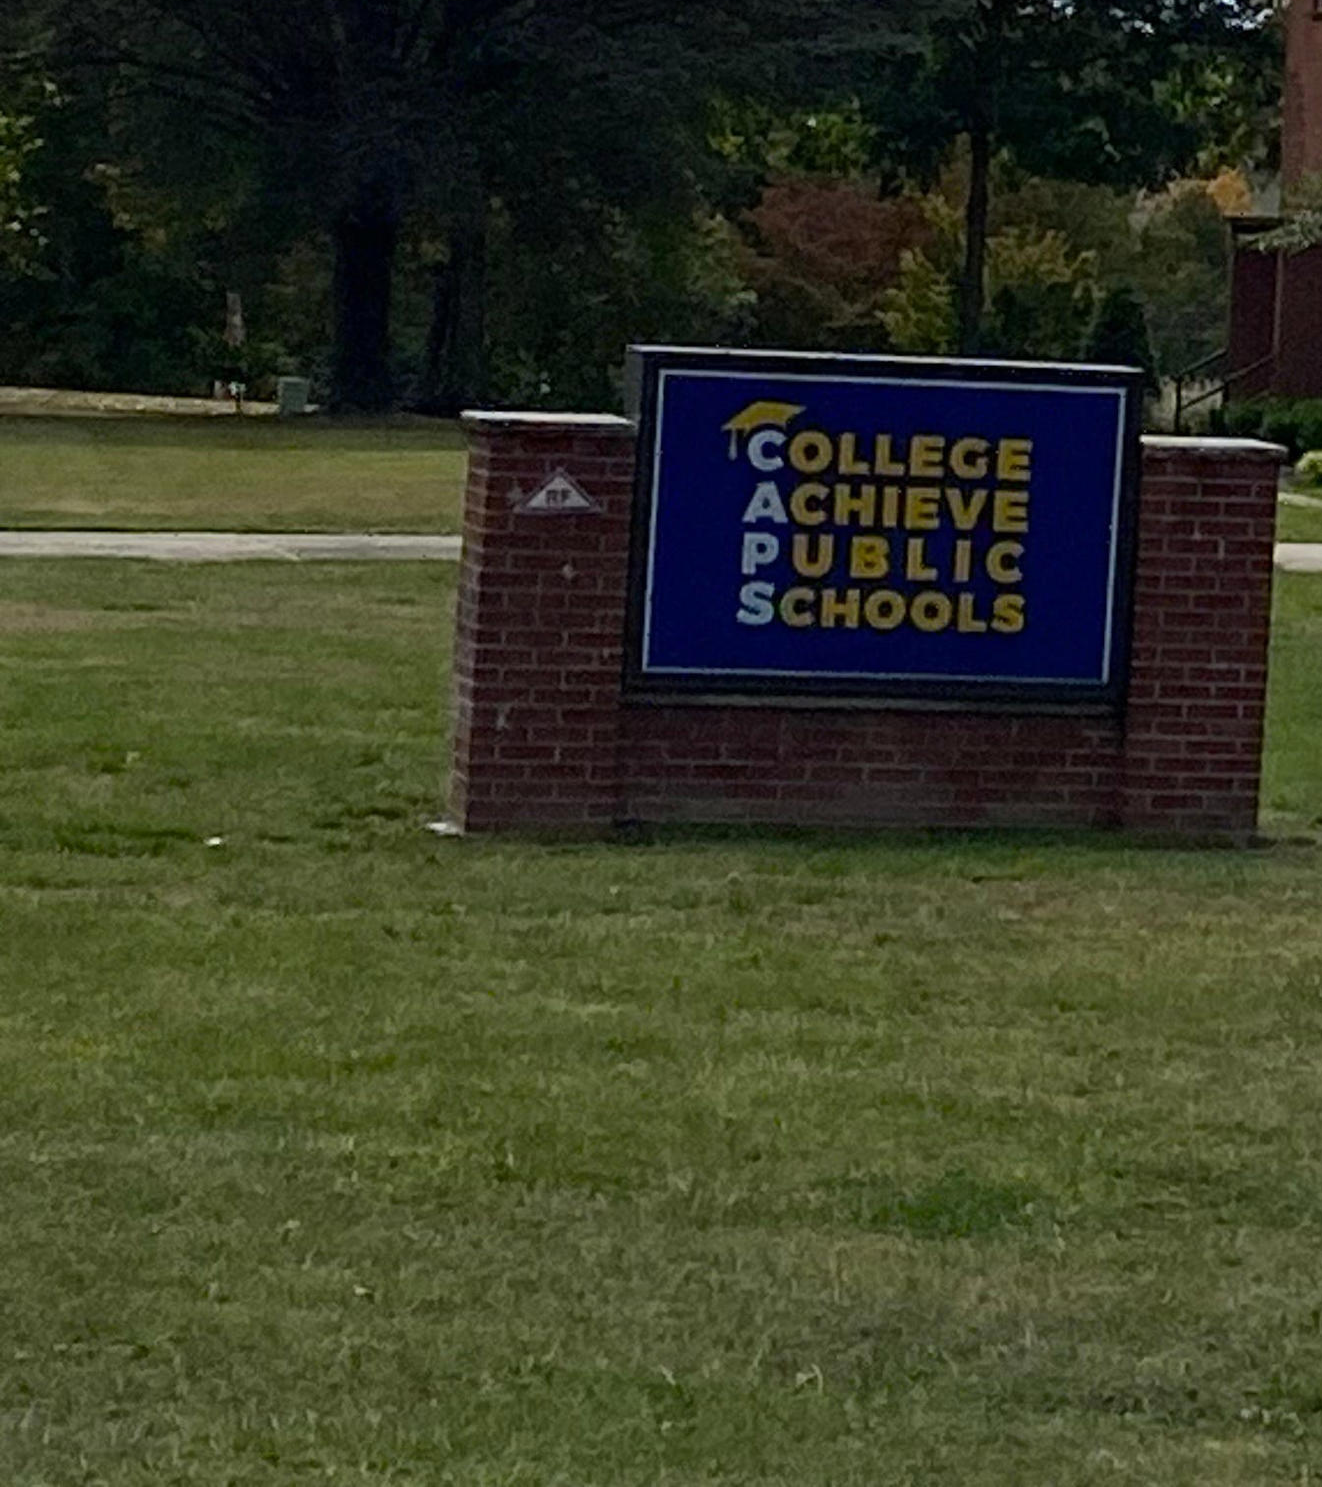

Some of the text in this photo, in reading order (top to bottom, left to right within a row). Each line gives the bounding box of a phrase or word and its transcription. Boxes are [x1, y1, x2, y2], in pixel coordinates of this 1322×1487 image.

[746, 429, 1032, 481] COLLEGE
[743, 481, 1030, 532] ACHIEVE
[740, 532, 1025, 583] PUBLIC
[736, 581, 1026, 633] SCHOOLS
